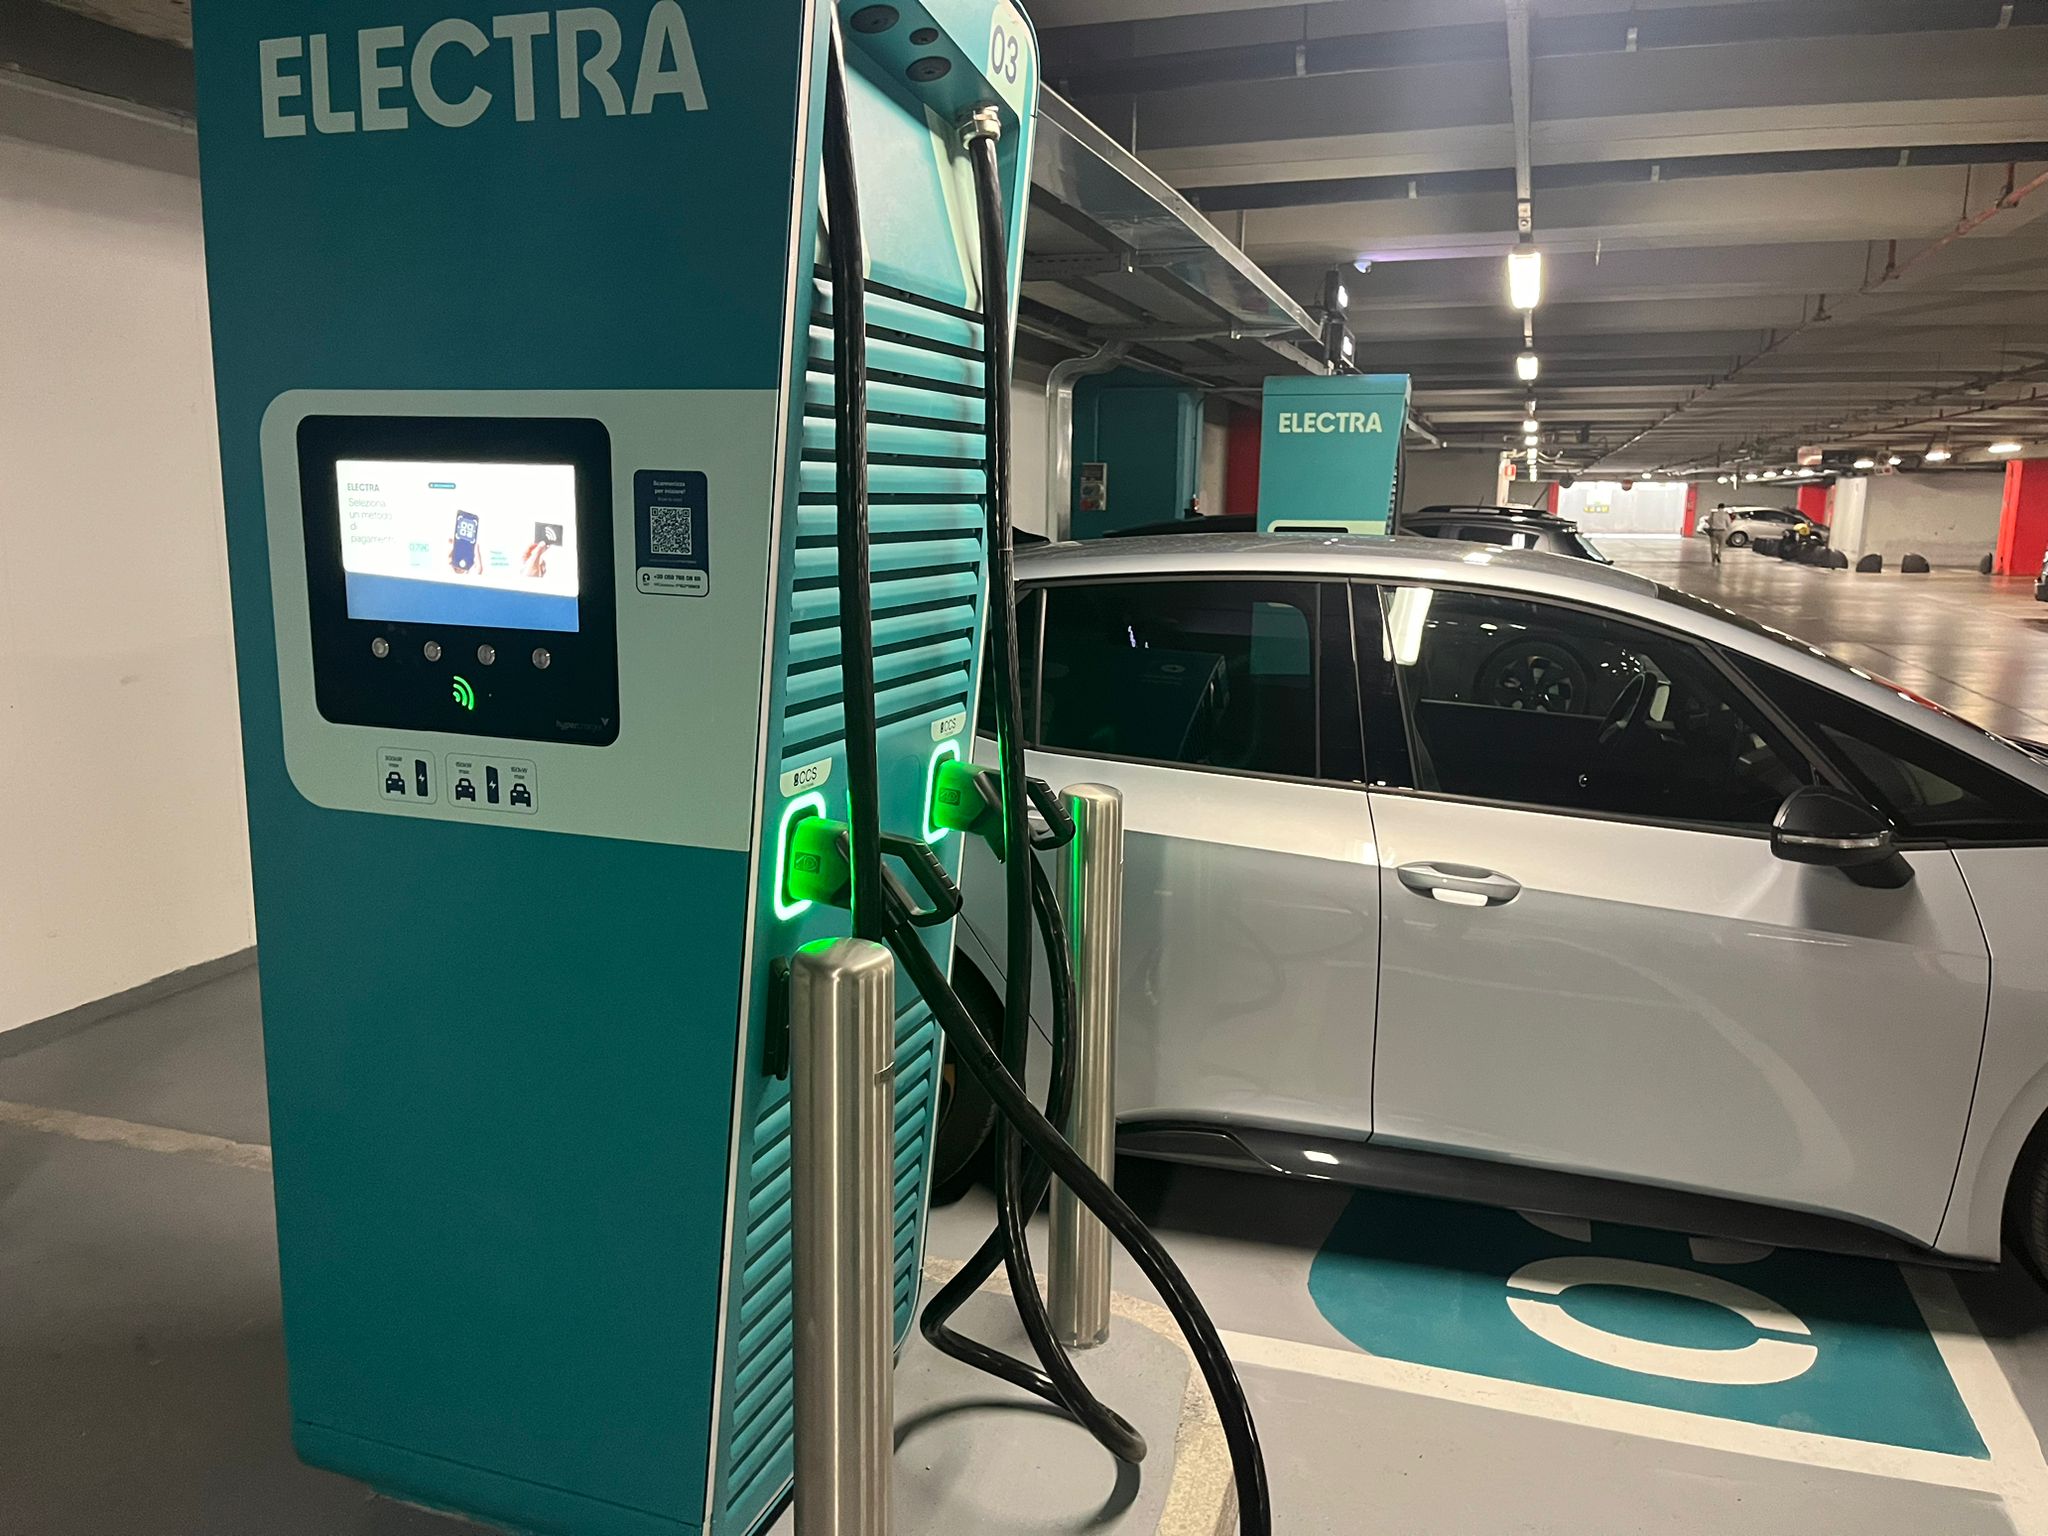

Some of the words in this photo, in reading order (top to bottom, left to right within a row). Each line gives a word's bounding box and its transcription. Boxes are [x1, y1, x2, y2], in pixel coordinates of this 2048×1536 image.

[992, 24, 1018, 84] 03
[259, 0, 709, 138] ELECTRA
[1278, 412, 1382, 433] ELECTRA
[347, 482, 380, 492] ELECTRA
[800, 766, 817, 784] CCS
